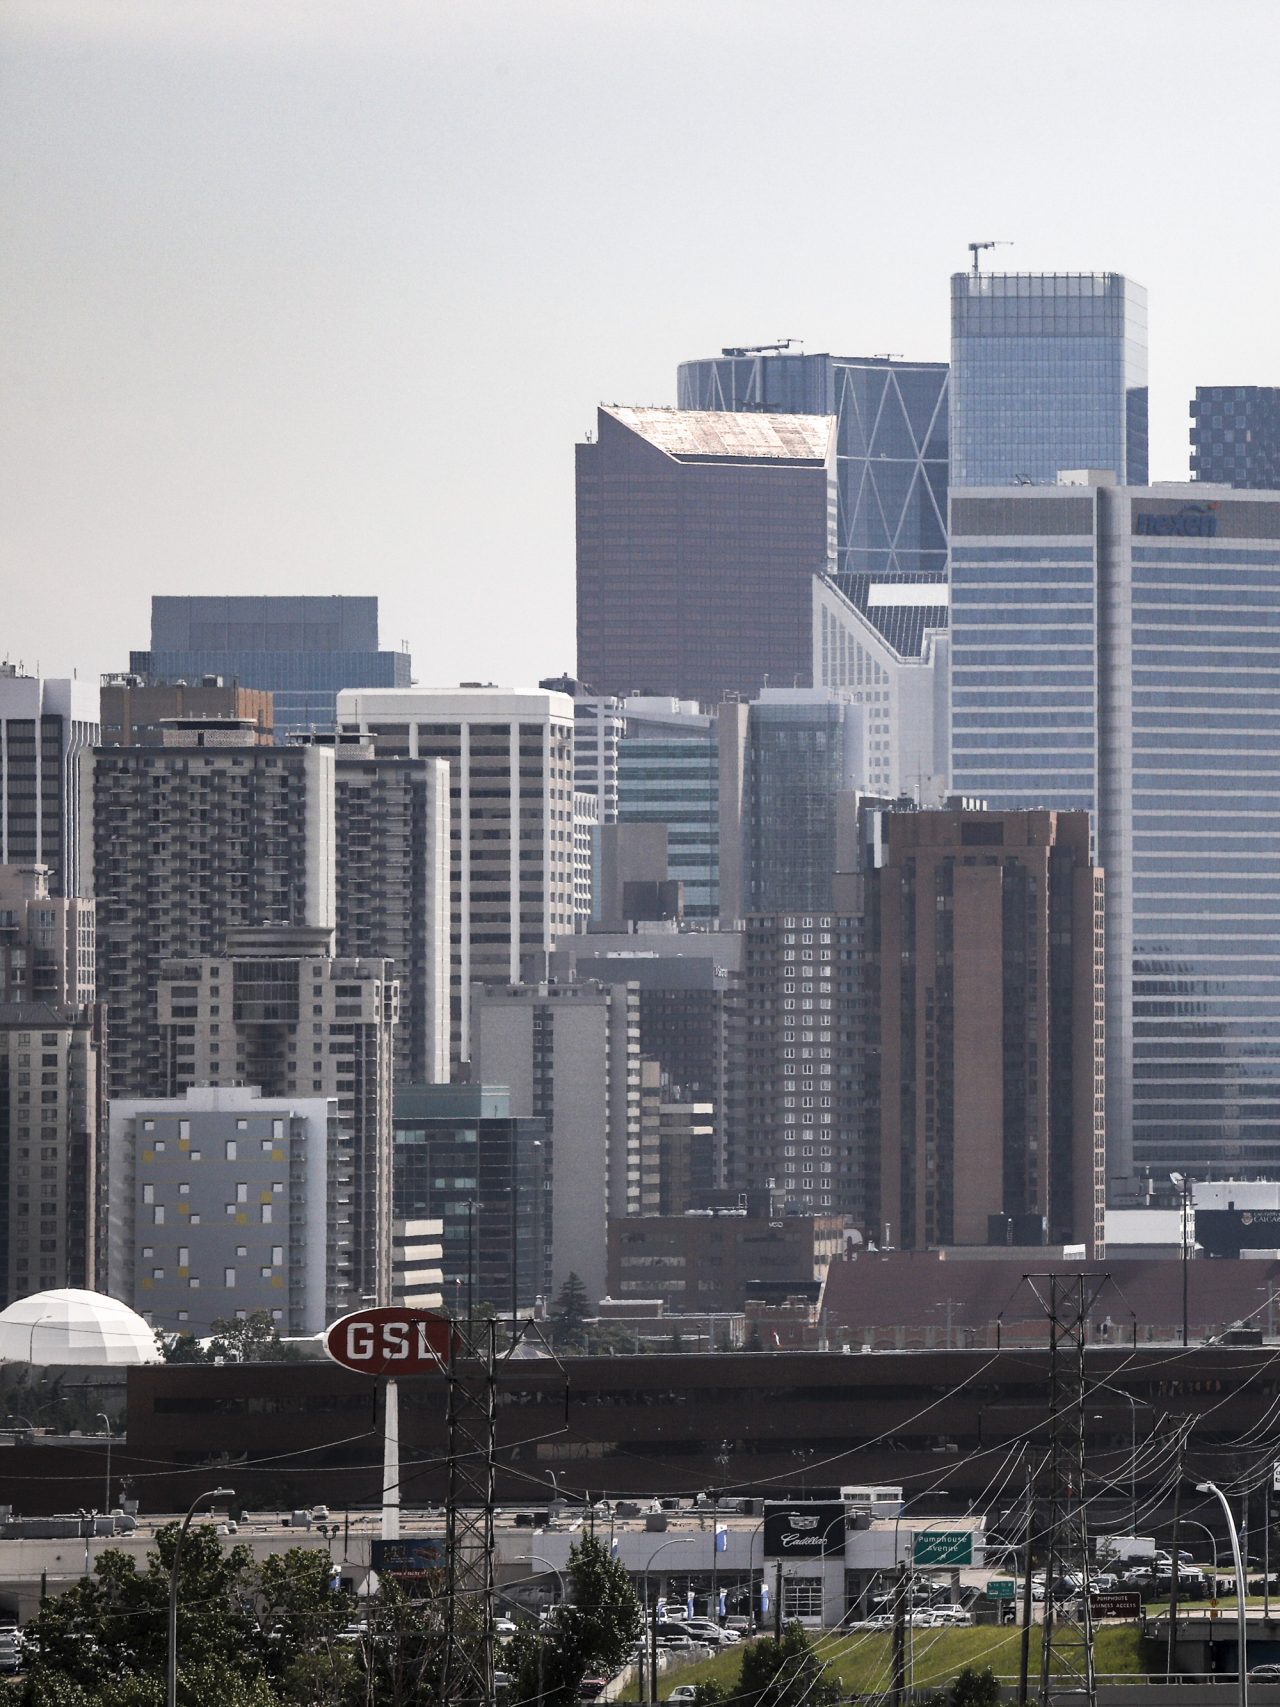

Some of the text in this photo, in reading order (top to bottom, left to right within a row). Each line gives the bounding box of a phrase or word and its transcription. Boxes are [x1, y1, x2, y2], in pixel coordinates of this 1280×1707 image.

[1138, 513, 1217, 537] nexen
[346, 1322, 442, 1360] GSL
[780, 1533, 828, 1548] Cadillac
